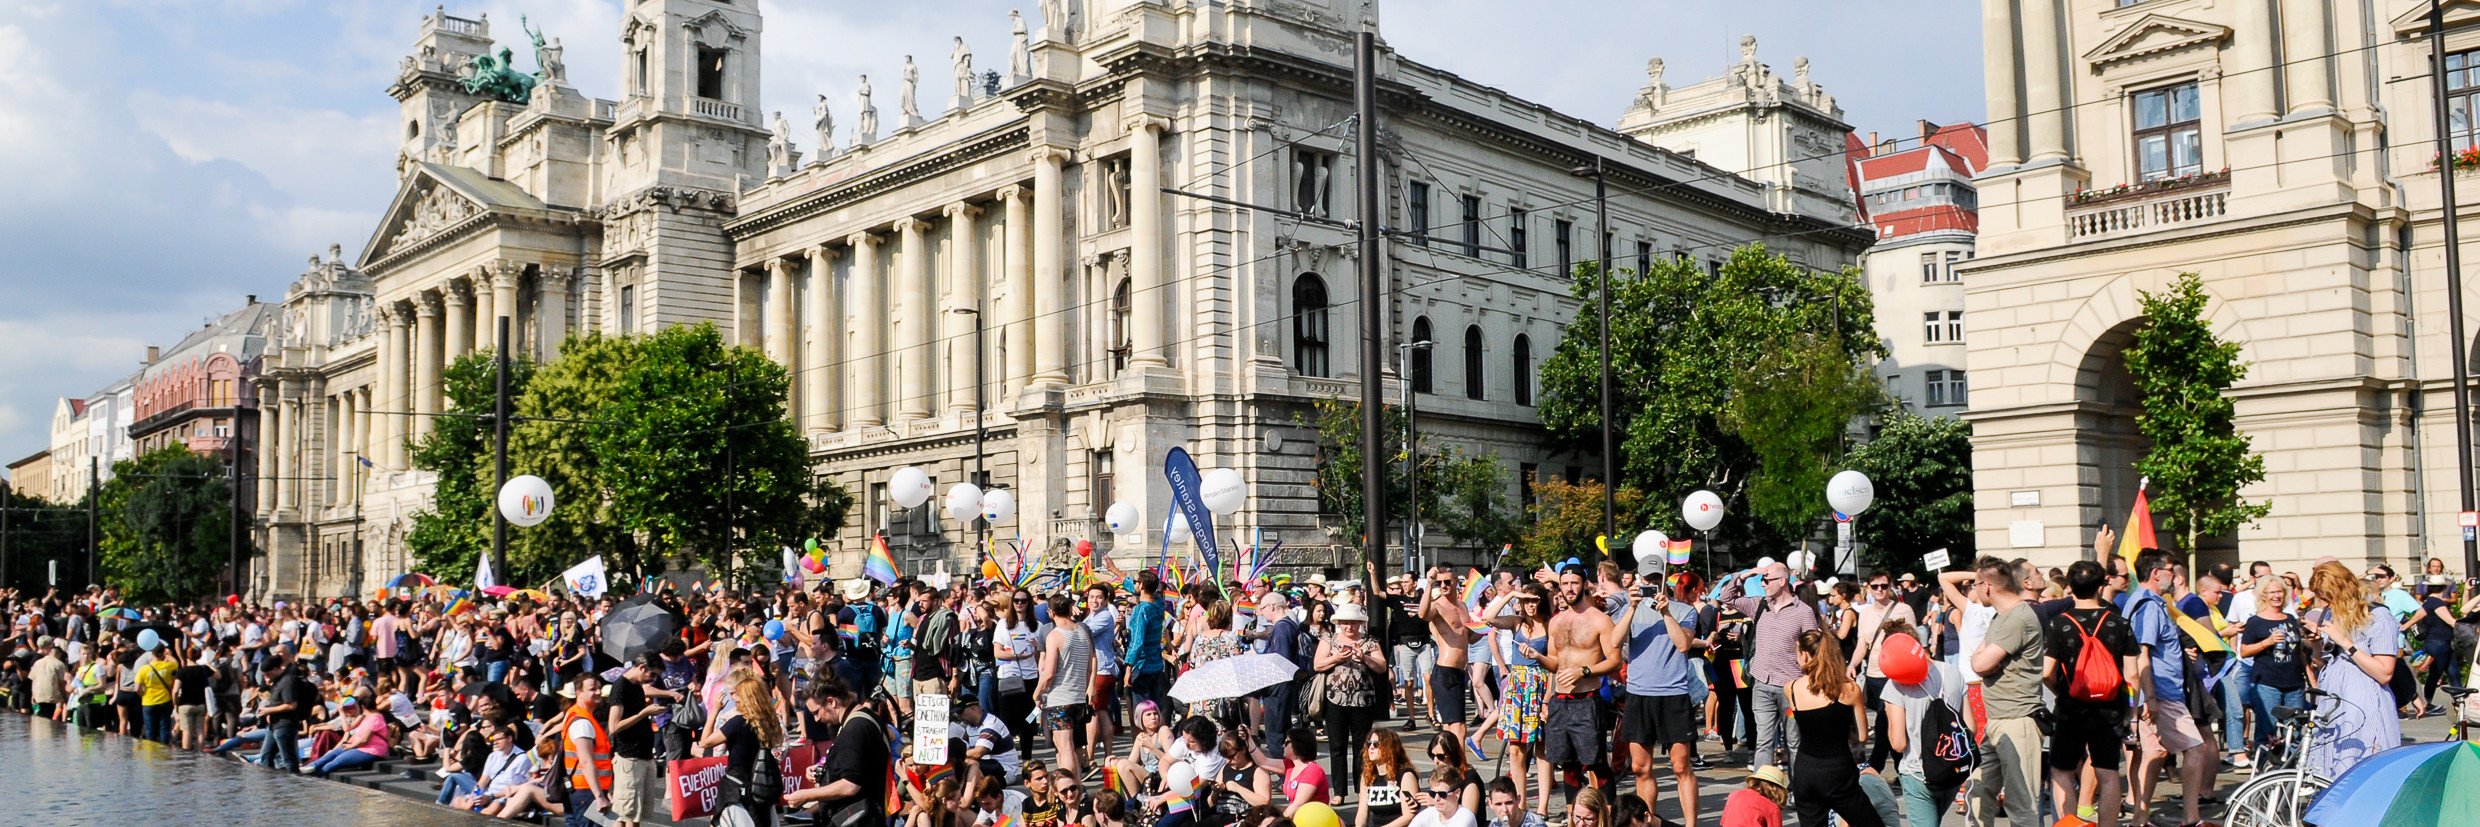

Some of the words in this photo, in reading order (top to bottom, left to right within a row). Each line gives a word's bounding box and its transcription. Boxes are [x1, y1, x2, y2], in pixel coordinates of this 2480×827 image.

[923, 735, 928, 747] I
[784, 756, 792, 773] A
[781, 774, 802, 796] ORY
[1367, 785, 1402, 806] EEK
